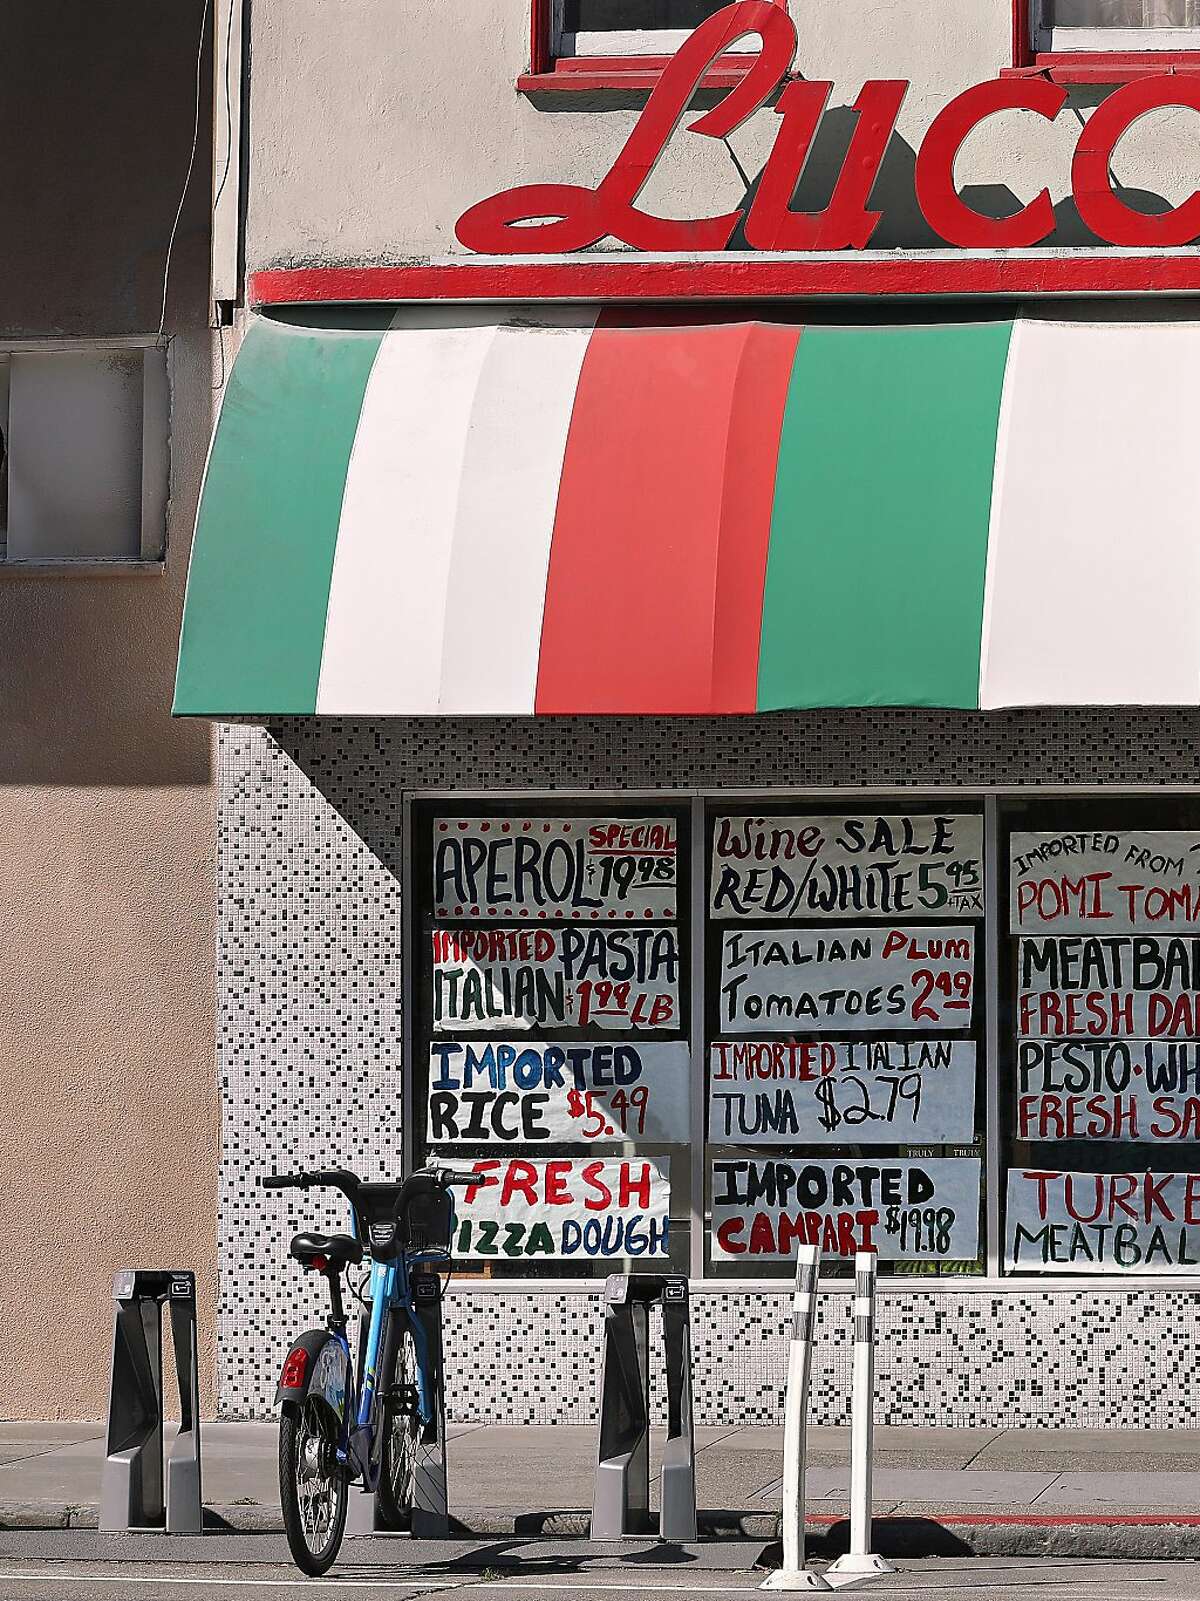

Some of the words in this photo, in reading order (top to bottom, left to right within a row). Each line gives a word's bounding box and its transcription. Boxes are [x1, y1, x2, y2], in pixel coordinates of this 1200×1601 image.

[589, 824, 677, 850] SPECIAL
[836, 817, 956, 856] SALE
[1013, 833, 1120, 876] IMPORTED
[1124, 844, 1184, 876] FROM
[436, 838, 603, 906] APEROL
[713, 859, 913, 917] RED/WHITE
[1017, 871, 1113, 925] POMI
[433, 930, 555, 963] IMPORTED
[558, 928, 678, 983] PASTA
[725, 932, 872, 969] ITALIAN
[434, 965, 564, 1021] ITALIAN
[631, 994, 673, 1025] LB
[1020, 993, 1133, 1036] FRESH
[431, 1043, 642, 1090] IMPORTED
[711, 1042, 836, 1081] IMPORTED
[840, 1042, 952, 1071] ITALIAN
[1020, 1043, 1129, 1094] PESTO
[430, 1091, 550, 1140] RICE
[567, 1087, 649, 1137] $5.49
[712, 1088, 799, 1136] TUNA
[814, 1073, 922, 1133] $2.79
[1020, 1094, 1138, 1139] FRESH
[907, 1149, 934, 1158] TRULY
[463, 1160, 650, 1211] FRESH
[713, 1161, 935, 1207] IMPORTED
[562, 1215, 669, 1256] DOUGH
[716, 1209, 879, 1257] CAMPARI
[884, 1205, 956, 1254] $19.98
